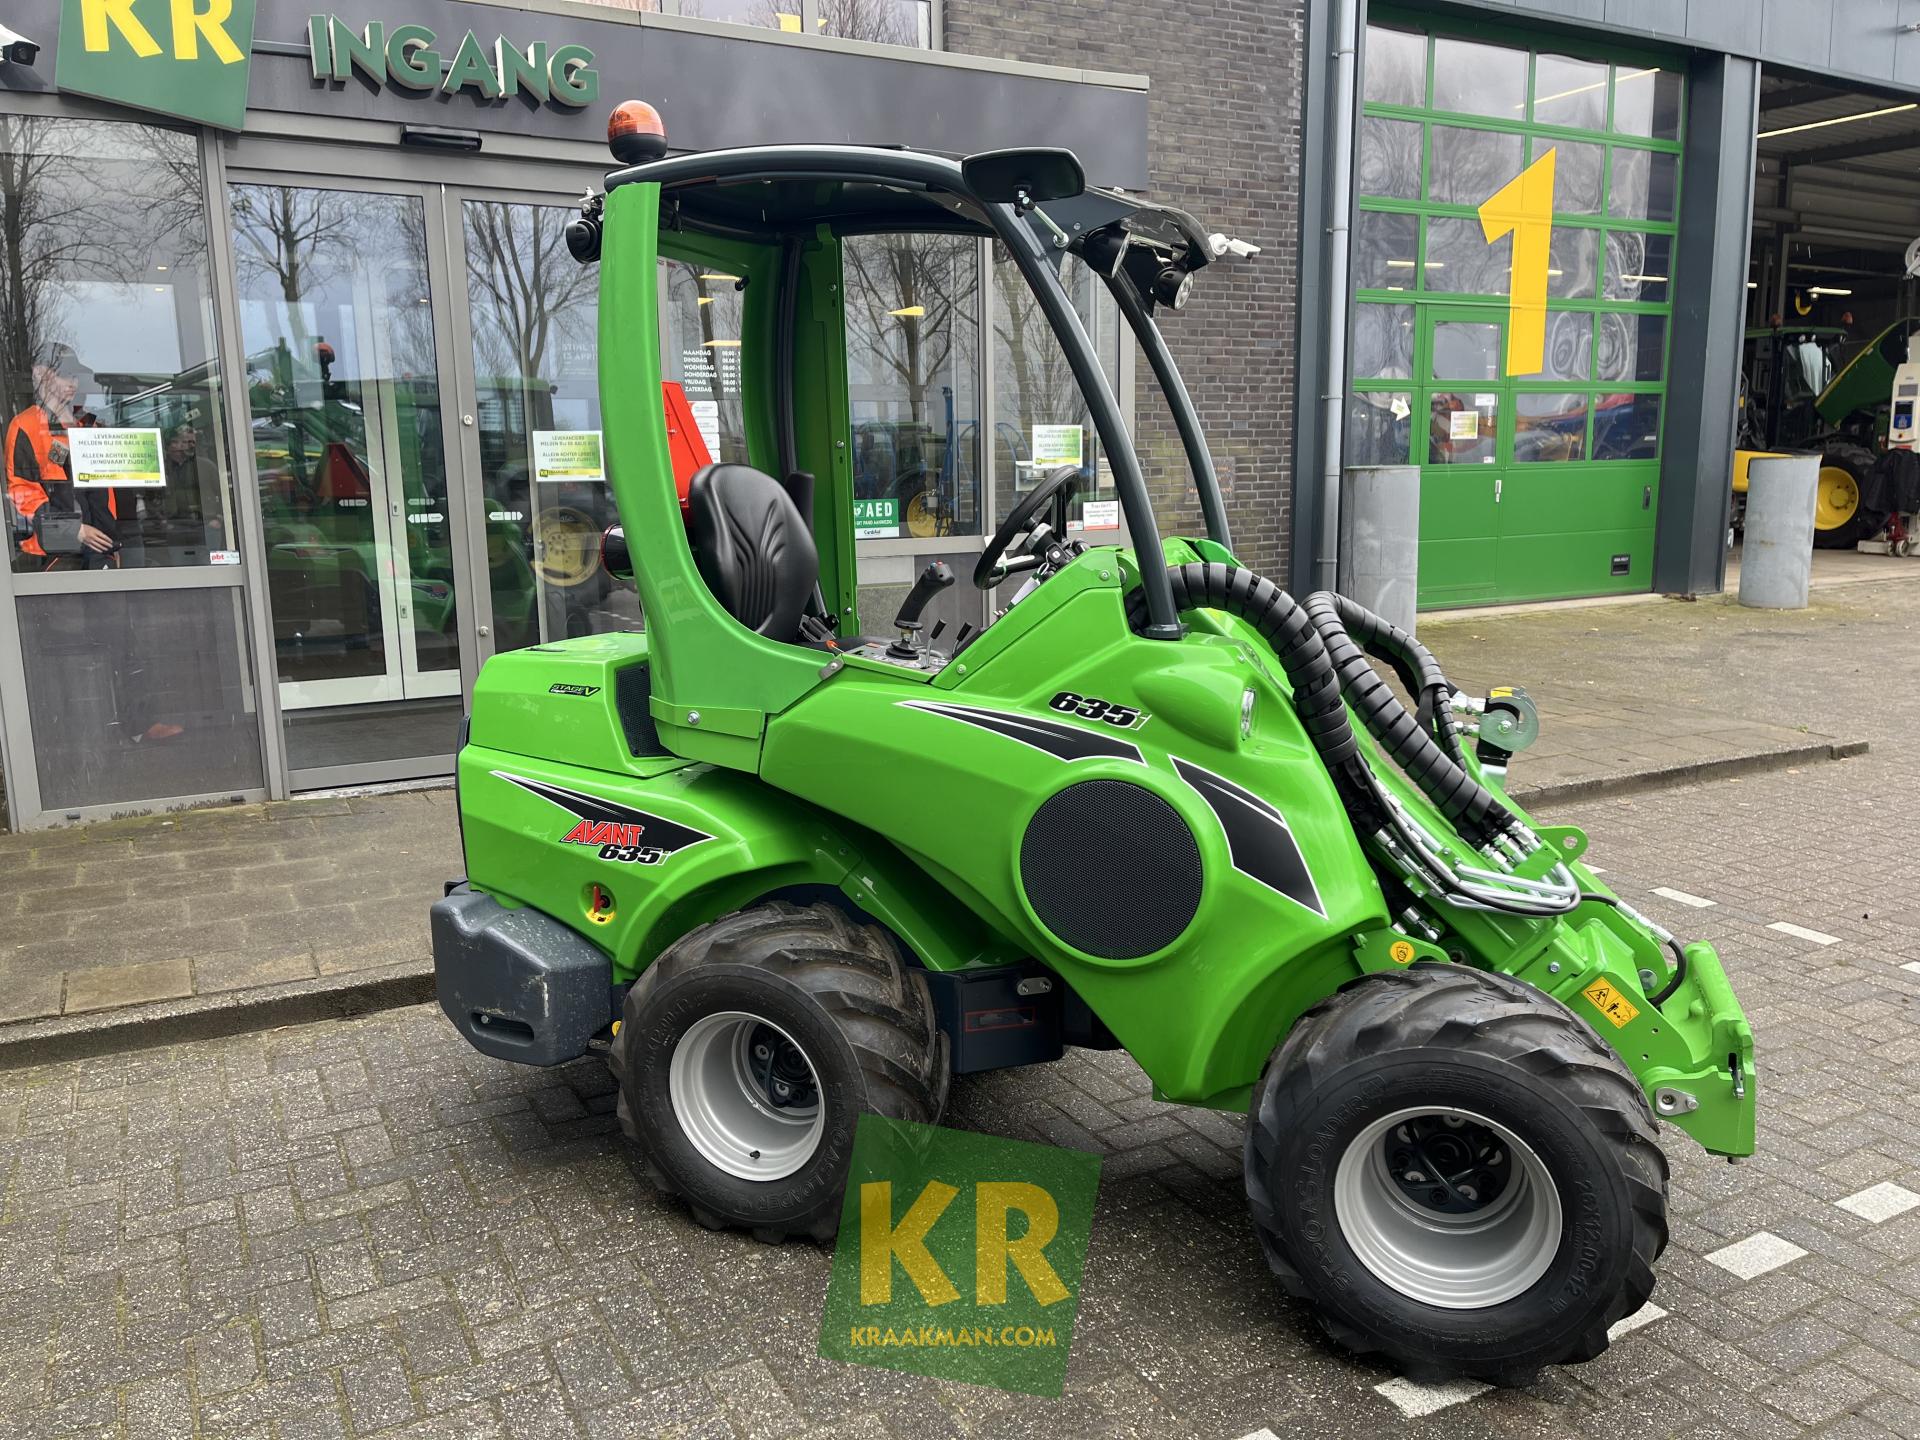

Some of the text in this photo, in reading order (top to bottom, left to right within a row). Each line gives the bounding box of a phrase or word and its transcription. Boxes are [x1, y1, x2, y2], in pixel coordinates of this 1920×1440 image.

[308, 14, 599, 107] INGANG
[1478, 146, 1556, 376] 1
[866, 502, 892, 517] AED
